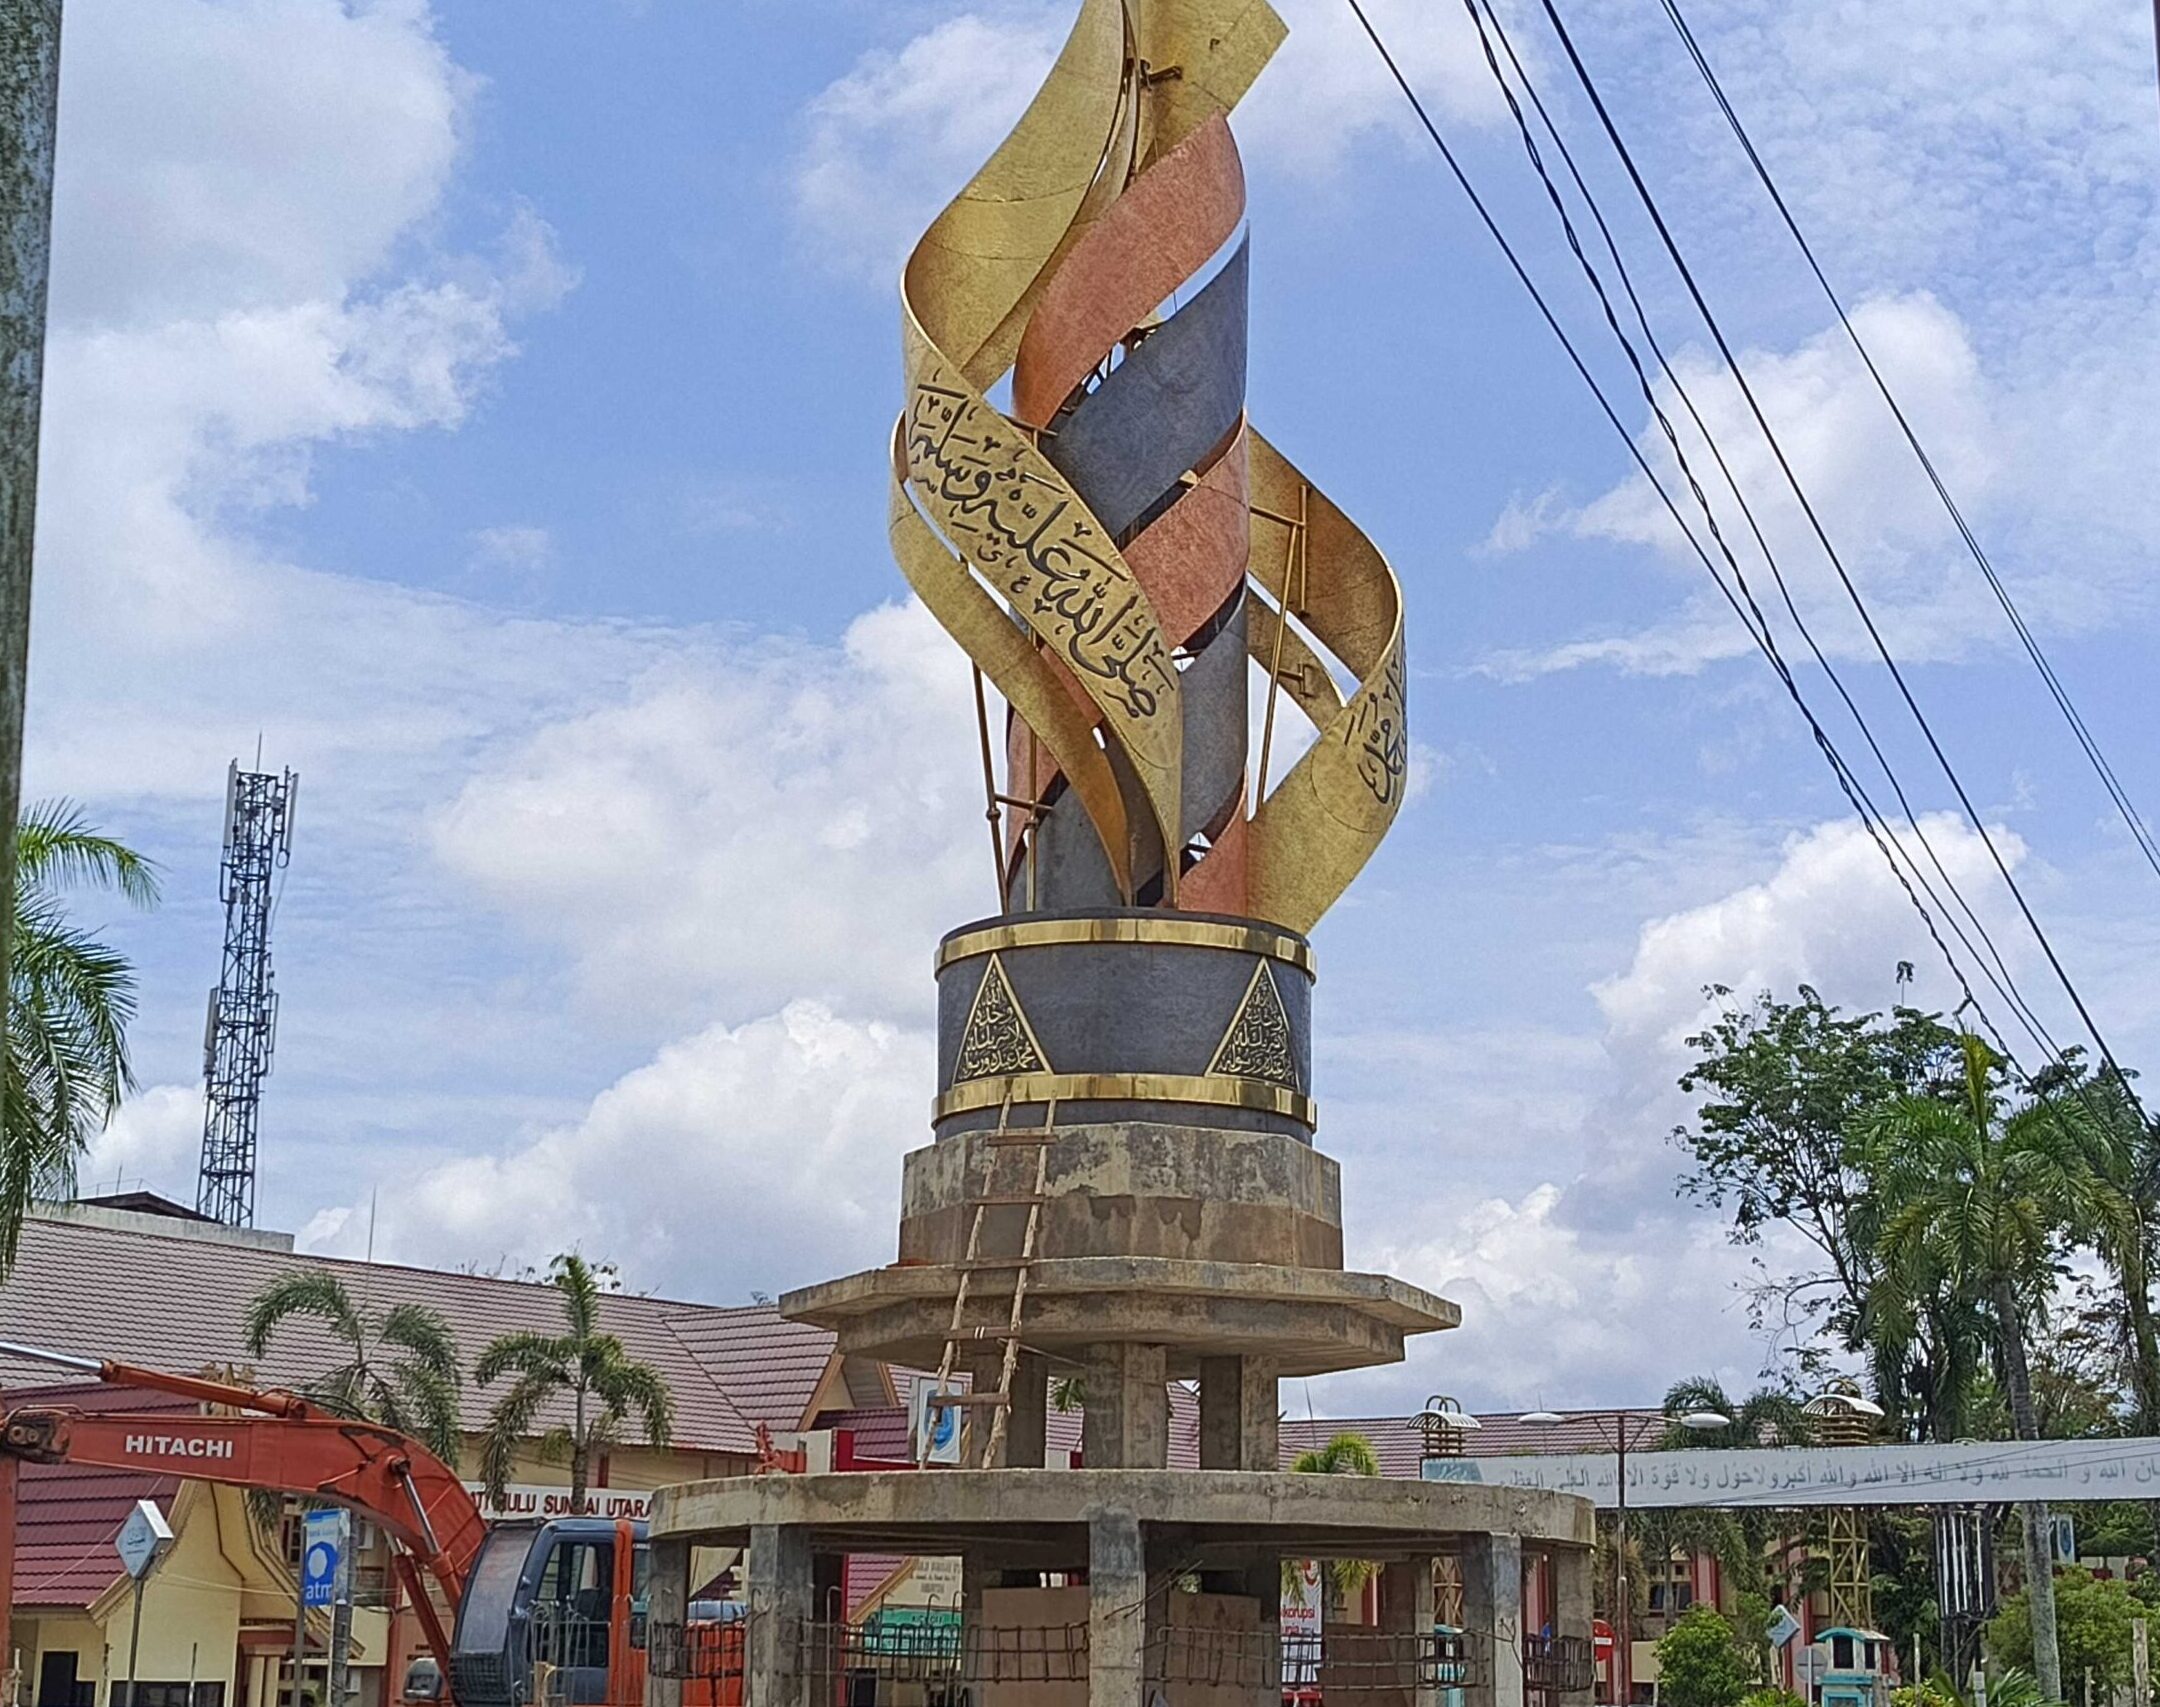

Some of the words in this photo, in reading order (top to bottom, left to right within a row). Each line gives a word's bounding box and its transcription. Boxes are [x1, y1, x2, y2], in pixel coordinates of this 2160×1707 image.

[125, 1435, 233, 1458] HITACHI
[499, 1492, 537, 1513] ULU
[543, 1494, 600, 1515] SUNAI
